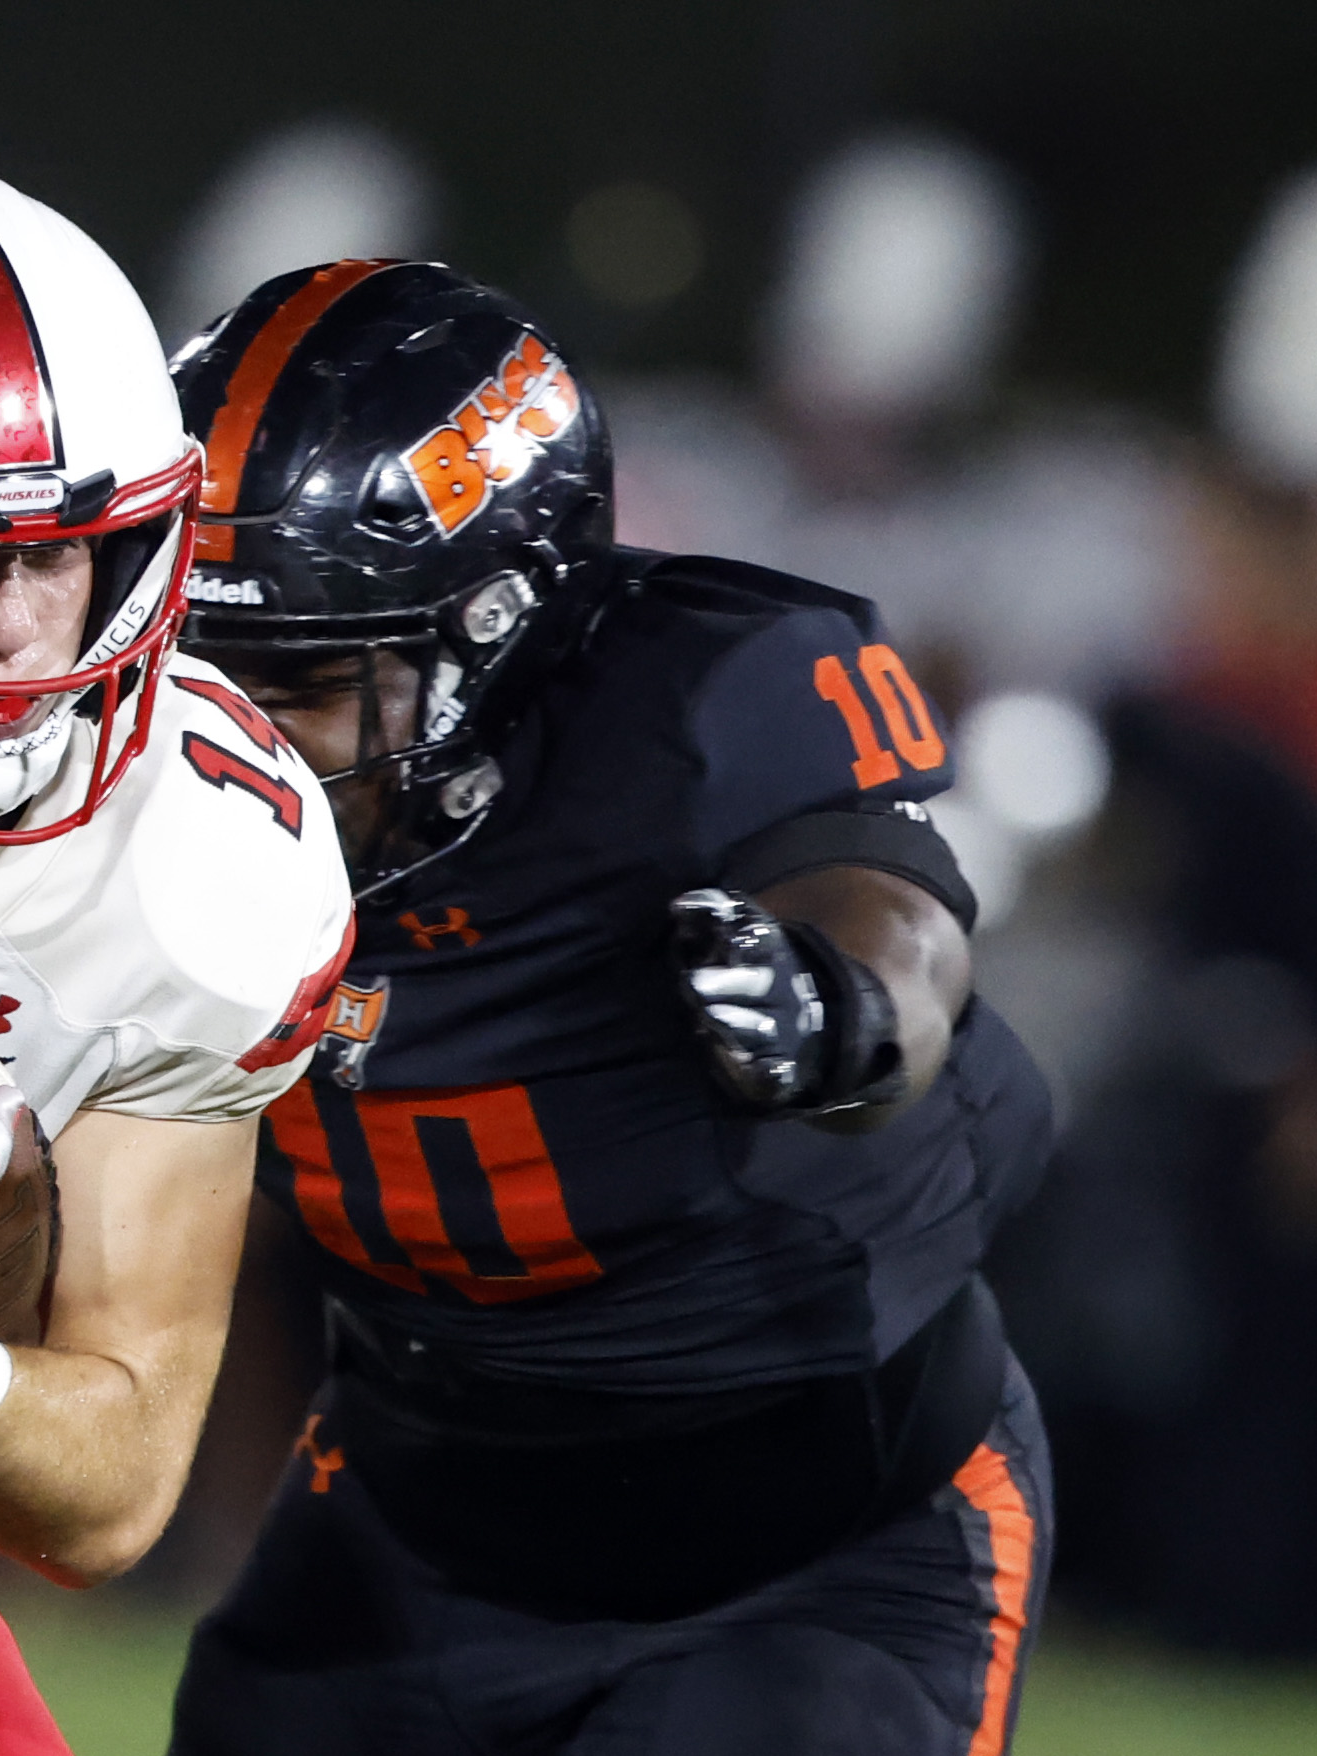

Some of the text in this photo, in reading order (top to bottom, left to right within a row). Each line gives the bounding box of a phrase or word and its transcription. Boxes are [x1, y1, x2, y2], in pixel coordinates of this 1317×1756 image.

[184, 572, 264, 604] ddell
[167, 674, 303, 842] 14
[814, 643, 947, 790] 10
[258, 1076, 605, 1303] 10
